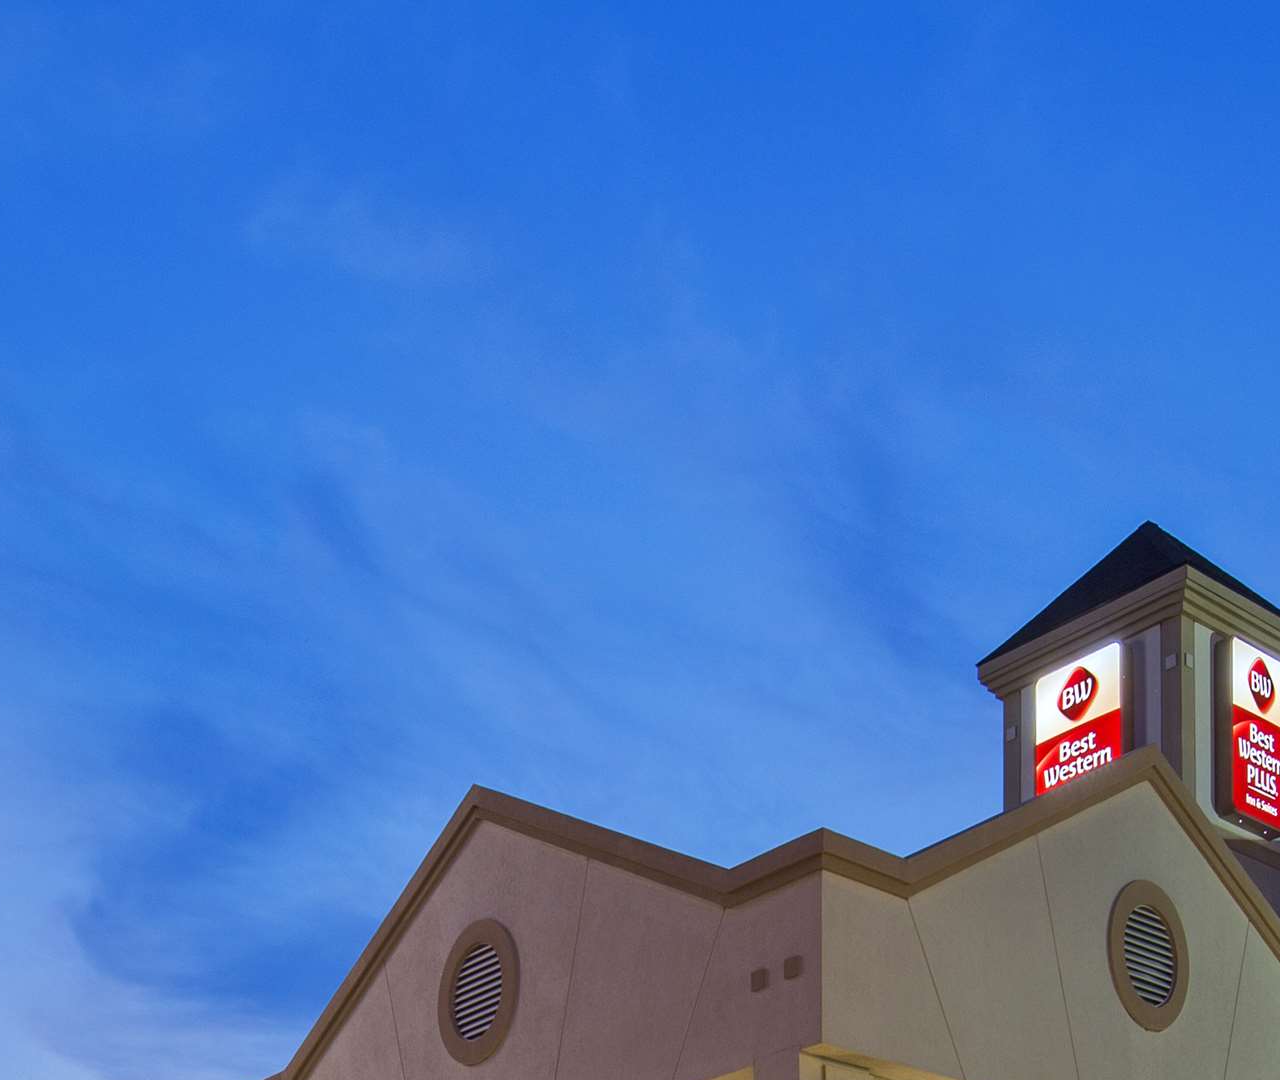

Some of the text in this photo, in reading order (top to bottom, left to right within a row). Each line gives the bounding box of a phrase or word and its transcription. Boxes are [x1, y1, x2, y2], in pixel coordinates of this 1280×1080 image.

[1062, 678, 1093, 710] BW
[1250, 671, 1271, 699] BW
[1059, 731, 1097, 763] Best
[1249, 722, 1275, 753] Best
[1043, 746, 1112, 788] Western
